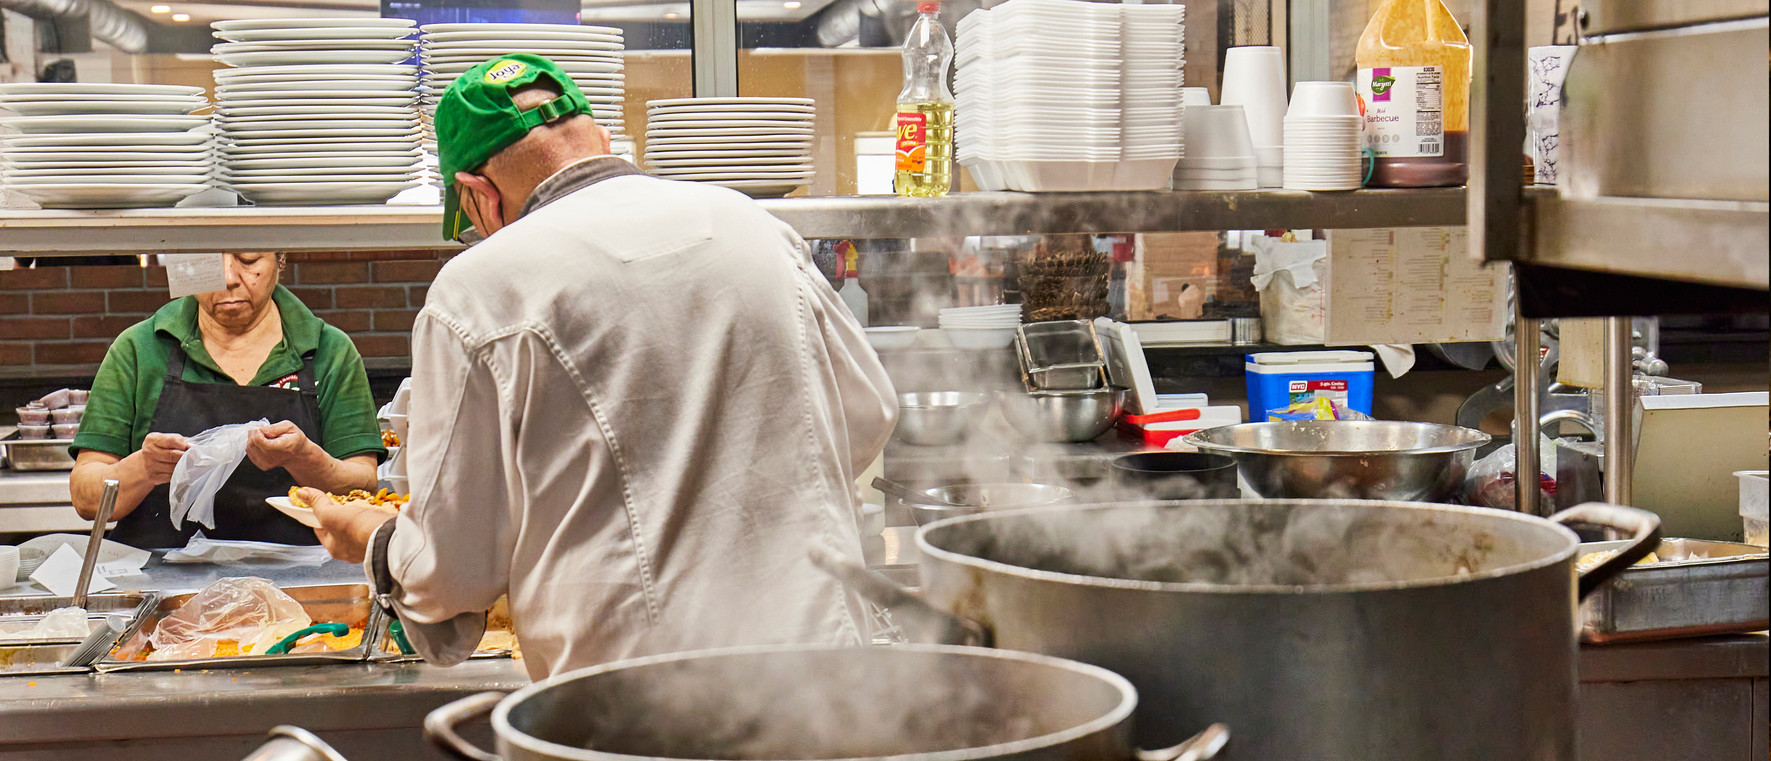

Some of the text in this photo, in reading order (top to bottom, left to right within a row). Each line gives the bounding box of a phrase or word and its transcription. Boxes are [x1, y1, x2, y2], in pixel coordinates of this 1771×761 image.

[489, 63, 521, 80] Joya
[1367, 115, 1399, 123] Barbecue
[898, 124, 917, 140] ve
